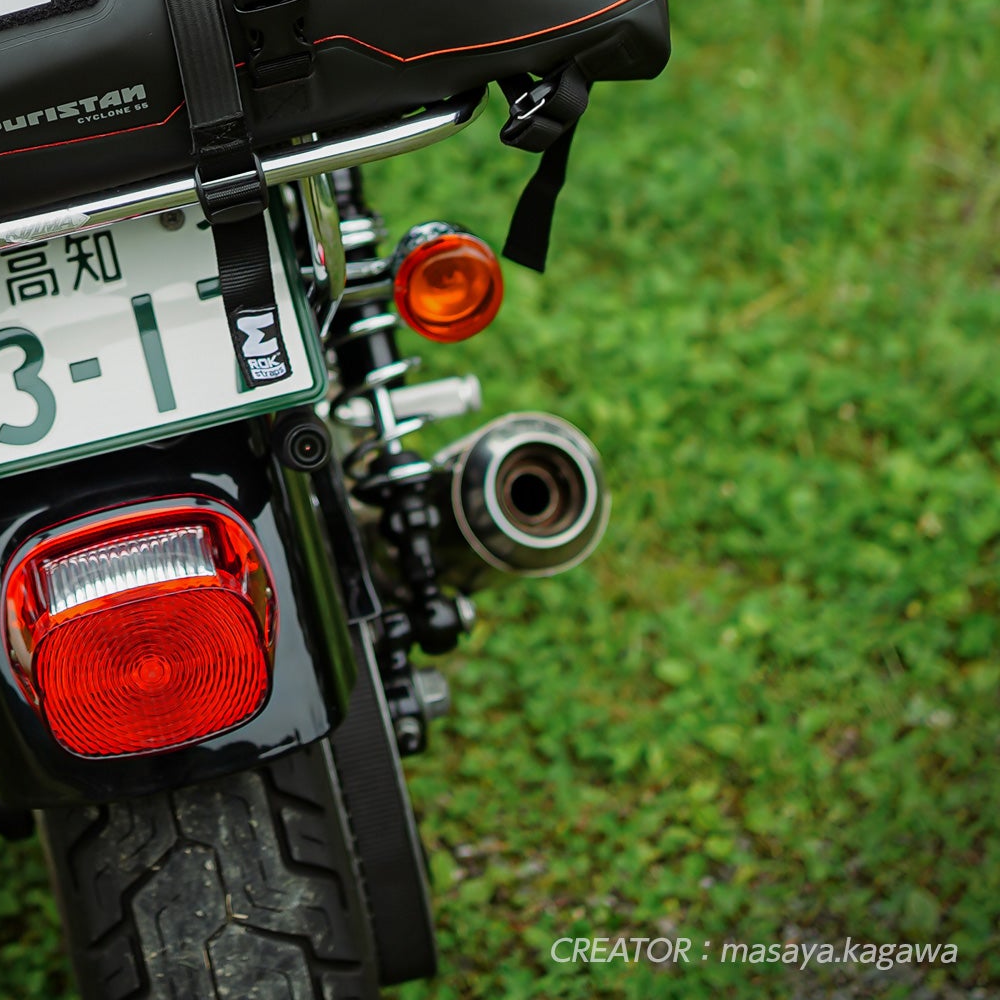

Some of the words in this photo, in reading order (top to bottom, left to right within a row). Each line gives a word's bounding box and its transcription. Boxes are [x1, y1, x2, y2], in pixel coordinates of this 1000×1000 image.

[77, 106, 131, 124] CYCLONE
[1, 229, 123, 306] 高知
[247, 354, 280, 370] ROK
